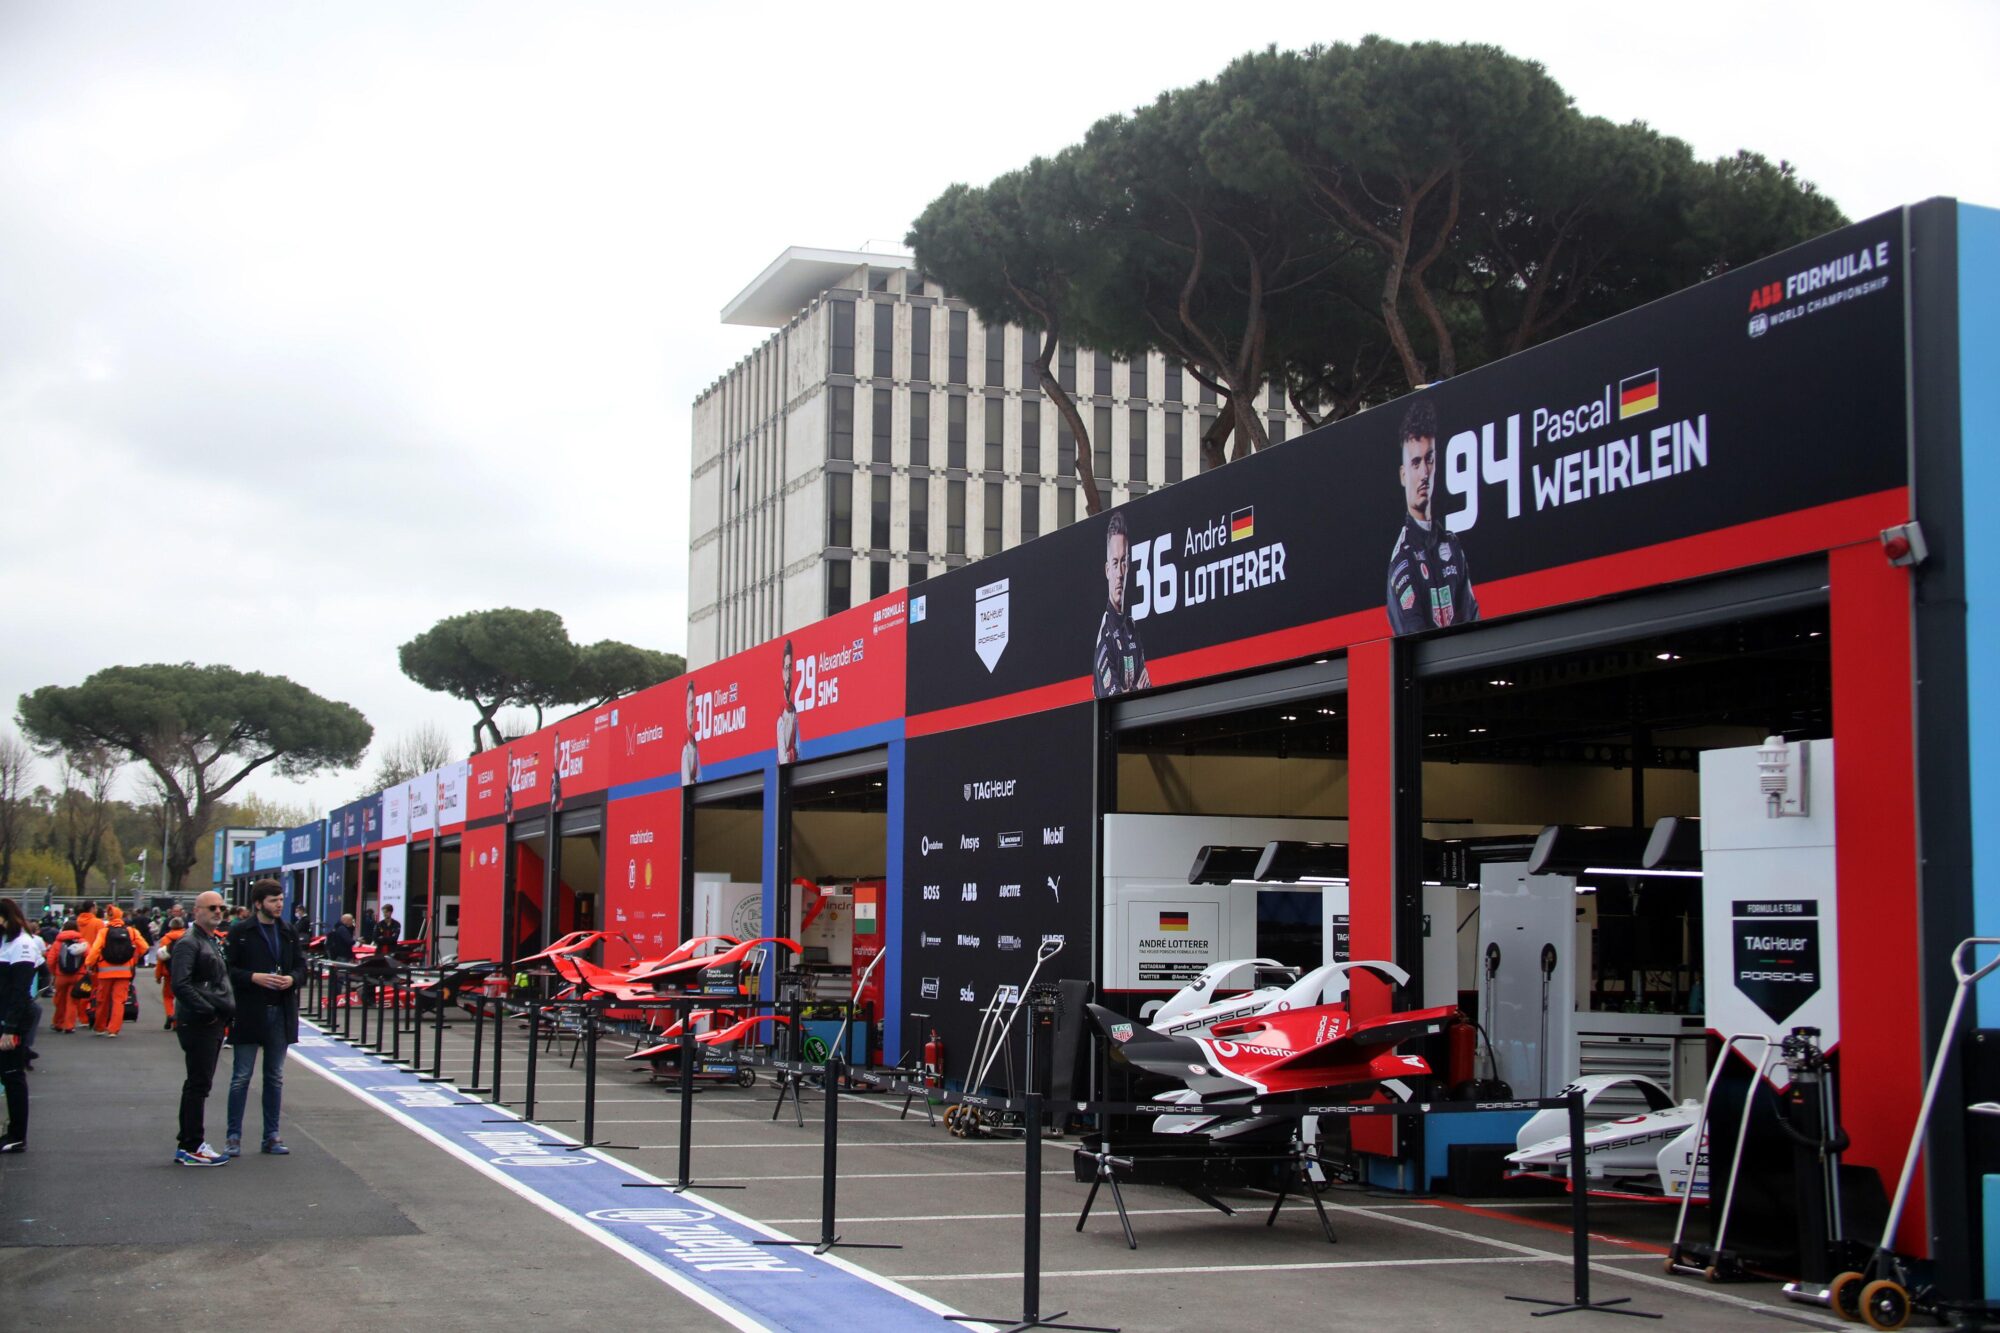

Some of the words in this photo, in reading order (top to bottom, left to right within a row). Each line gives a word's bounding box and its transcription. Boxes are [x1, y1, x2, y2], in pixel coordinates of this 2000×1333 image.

[1749, 281, 1783, 313] ABB
[1785, 247, 1873, 300] FORMULA
[1875, 241, 1889, 268] E
[1769, 304, 1805, 326] WORLD
[1806, 275, 1889, 313] CHAMPIONSHIP
[1532, 384, 1611, 448] Pascal
[1531, 413, 1709, 512] WEHRLEIN
[1444, 413, 1520, 534] 94
[1183, 515, 1227, 558] André
[1131, 532, 1177, 622] 36
[1184, 541, 1287, 607] LOTTERER
[882, 603, 901, 620] FORMULA
[978, 632, 1006, 644] PORSCHE
[818, 645, 852, 673] Alexander
[794, 655, 816, 713] 29
[817, 676, 838, 707] SIMS
[714, 689, 729, 708] Oliver
[695, 691, 712, 742] 30
[713, 705, 746, 736] ROWLAND
[637, 725, 663, 745] mahindra
[973, 779, 1017, 800] TAGHeuer
[960, 834, 980, 852] Ansys
[1043, 826, 1064, 846] Mobil
[923, 885, 940, 900] BOSS
[961, 882, 978, 901] ABB
[999, 884, 1021, 897] LOCTITE
[1747, 904, 1779, 913] FORMULA
[1784, 904, 1803, 913] TEAM
[963, 934, 980, 948] NetApp
[1139, 938, 1167, 948] ANDRÉ
[1168, 940, 1209, 949] LOTTERER
[1744, 936, 1808, 951] TAGHeuer
[1740, 971, 1814, 982] PORSCHE
[1169, 1000, 1273, 1035] PORSCH
[907, 1085, 929, 1095] PORSCHE
[1476, 1101, 1539, 1109] PORSCHE
[645, 1224, 804, 1272] Allianz
